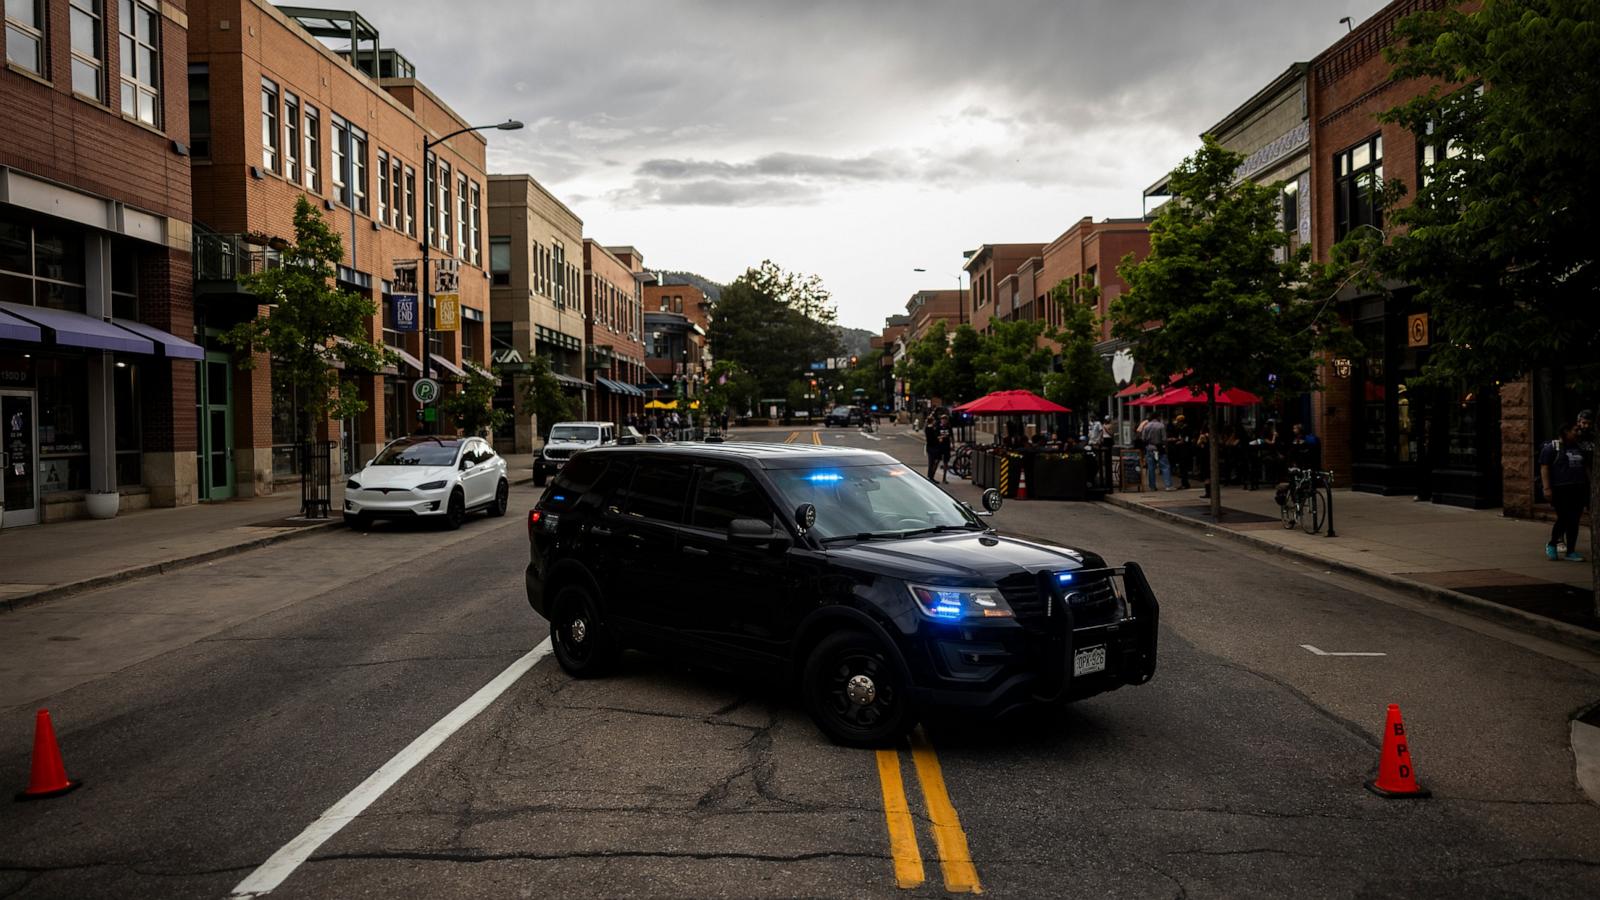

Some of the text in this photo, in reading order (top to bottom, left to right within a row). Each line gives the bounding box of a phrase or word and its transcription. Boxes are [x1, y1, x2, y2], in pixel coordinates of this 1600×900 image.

[397, 301, 414, 311] EAST
[440, 302, 456, 311] EAST
[397, 311, 414, 321] END
[440, 311, 456, 321] END
[420, 385, 431, 397] P
